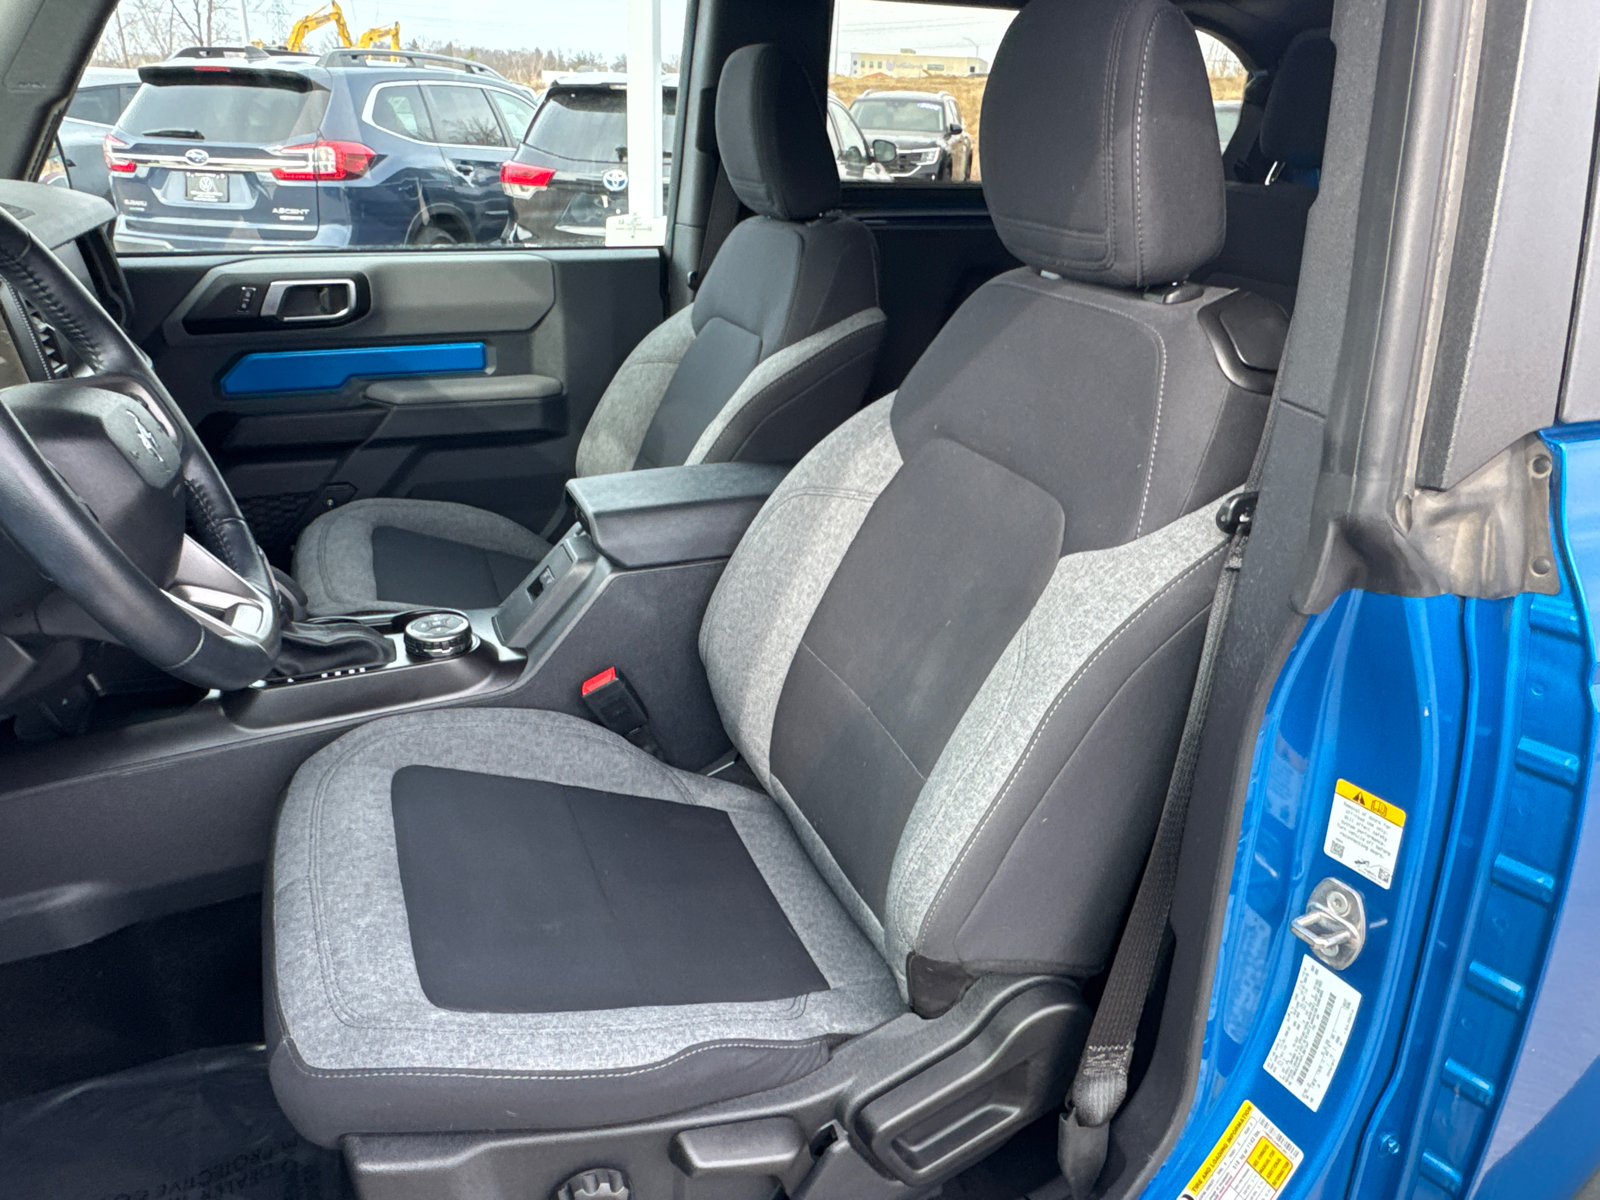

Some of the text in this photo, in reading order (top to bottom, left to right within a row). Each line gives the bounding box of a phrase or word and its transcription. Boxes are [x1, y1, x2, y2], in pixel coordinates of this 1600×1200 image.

[272, 207, 310, 215] ASCENT
[1246, 1137, 1256, 1148] 1143
[1192, 1106, 1253, 1192] TIRE AND LOADING INFORMATION
